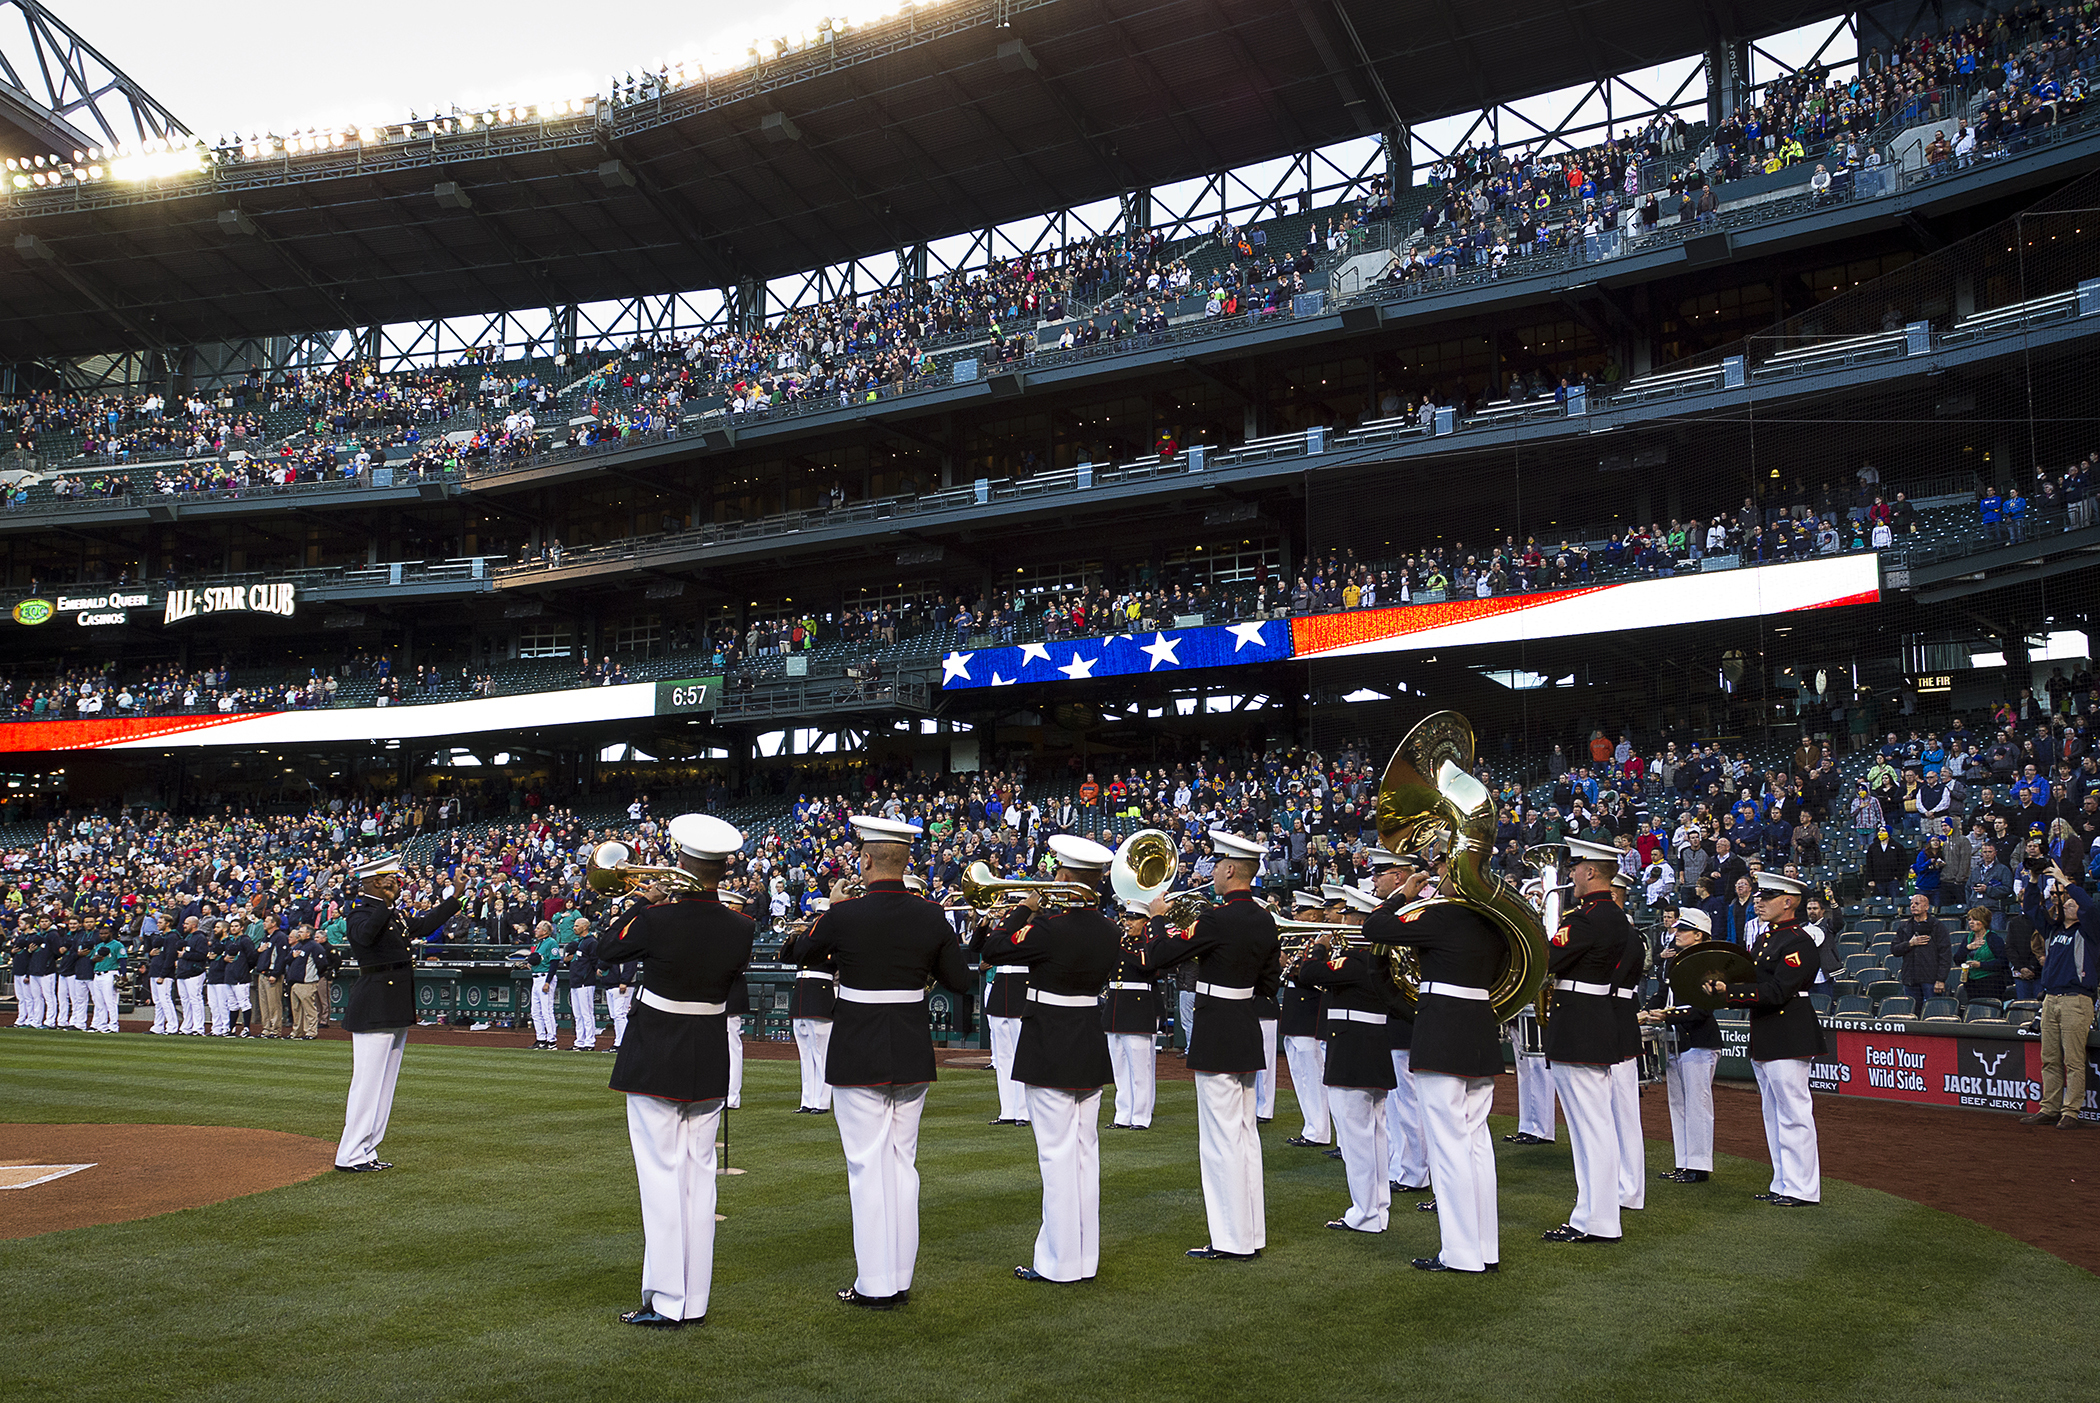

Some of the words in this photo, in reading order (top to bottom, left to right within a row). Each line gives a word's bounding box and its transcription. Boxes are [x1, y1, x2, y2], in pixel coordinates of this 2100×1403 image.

[1704, 57, 1714, 85] 325
[1729, 51, 1739, 78] 326
[1382, 135, 1392, 161] 323
[1120, 199, 1129, 223] 321
[248, 583, 295, 616] CLUB
[21, 605, 47, 620] EQC
[1918, 677, 1934, 687] THE
[672, 685, 707, 707] 6:57
[1865, 1045, 1895, 1067] Feed
[1895, 1047, 1926, 1070] Your
[1809, 1081, 1838, 1091] JERKY
[1867, 1067, 1895, 1089] Wild
[1896, 1069, 1928, 1092] Side.
[1943, 1074, 1983, 1095] JACK
[1986, 1078, 2041, 1101] LINK'S
[1960, 1096, 1988, 1106] BEEF
[1989, 1099, 2025, 1111] JERKY
